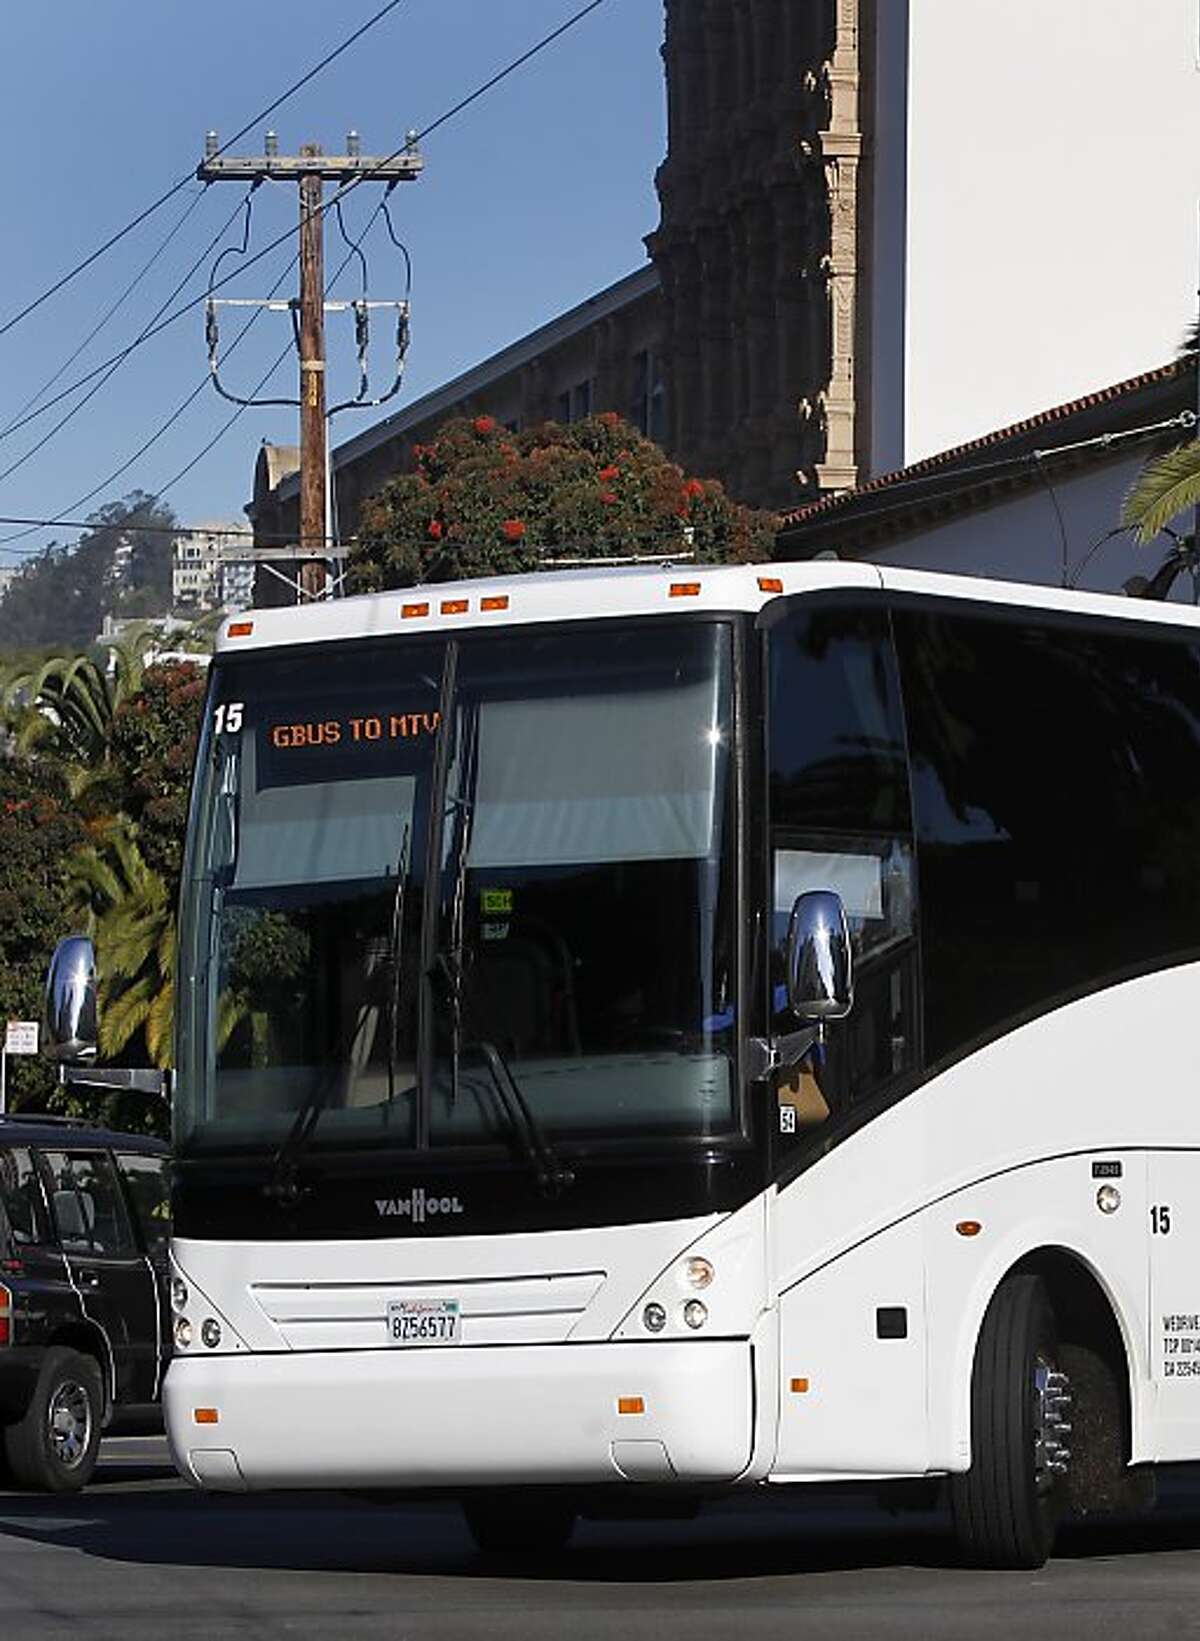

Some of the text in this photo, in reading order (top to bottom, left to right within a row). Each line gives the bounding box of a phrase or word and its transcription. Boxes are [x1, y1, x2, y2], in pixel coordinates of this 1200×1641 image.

[213, 702, 245, 735] 15
[272, 711, 441, 748] GBUS TO MTV
[1150, 1205, 1171, 1235] 15
[392, 1316, 456, 1340] 8Z56577
